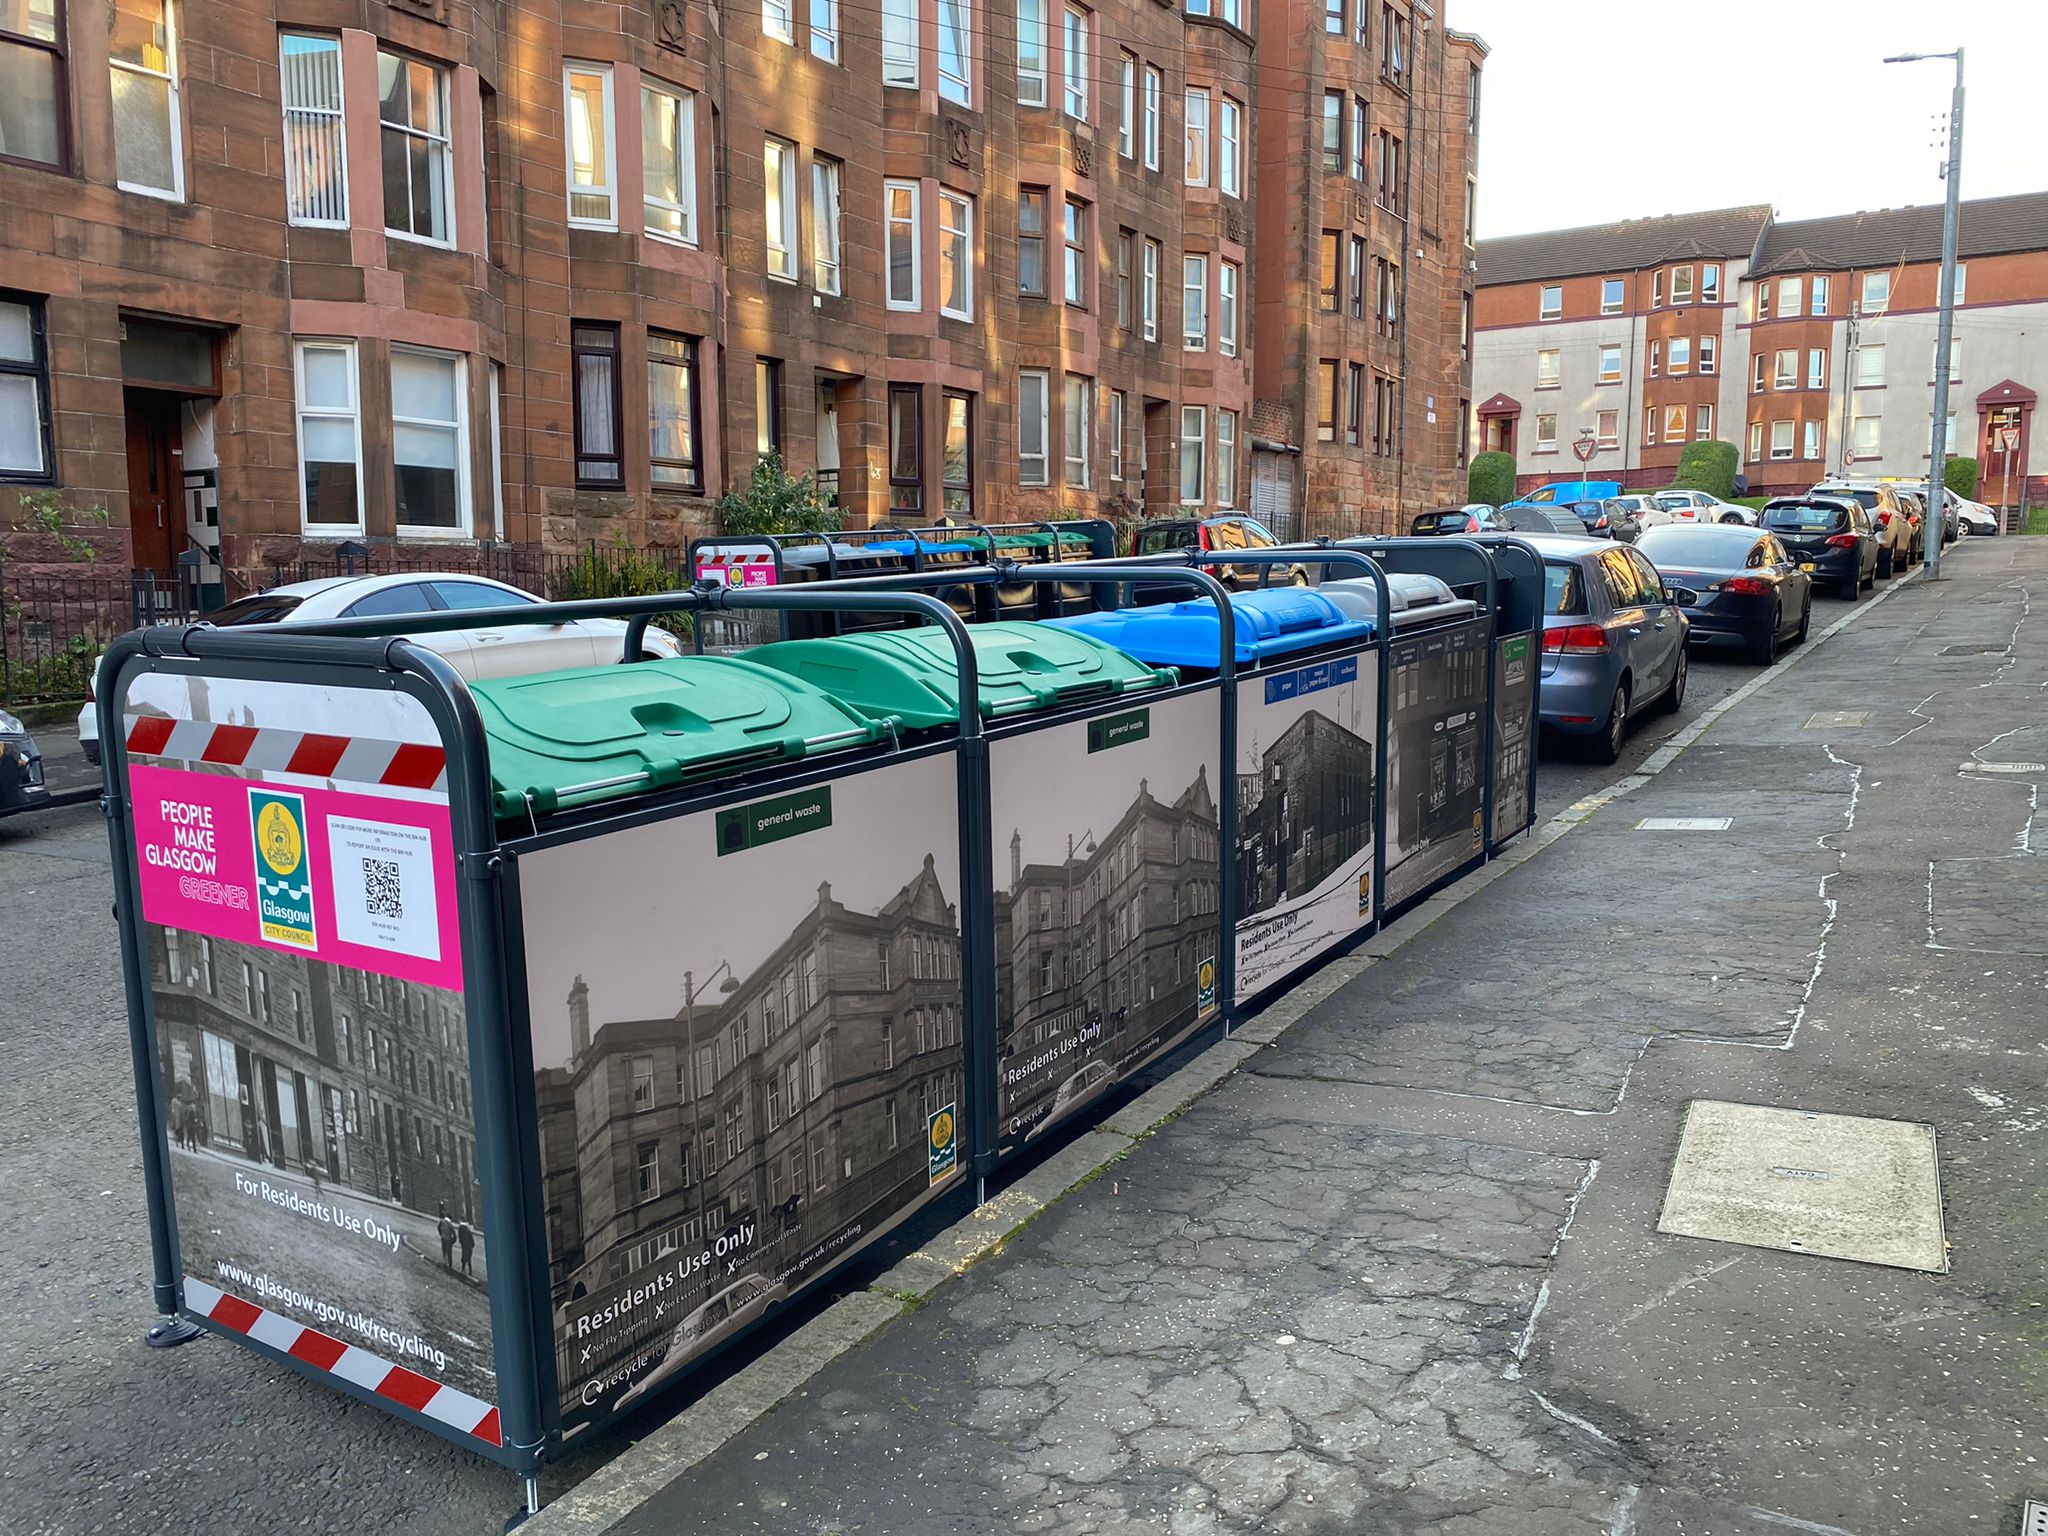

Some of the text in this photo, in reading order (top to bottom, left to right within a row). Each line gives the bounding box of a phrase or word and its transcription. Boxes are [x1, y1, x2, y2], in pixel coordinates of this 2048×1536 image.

[1109, 720, 1144, 738] general waste
[161, 800, 214, 828] PEOPLE
[757, 803, 821, 831] general waste
[174, 827, 216, 853] MAKE
[145, 844, 217, 876] GLASGOW
[179, 875, 250, 911] GREENER
[263, 899, 310, 925] Glasgow
[265, 925, 311, 943] CITY COUNCIL
[1241, 926, 1272, 952] Residents
[1272, 920, 1284, 934] Use
[1008, 1047, 1059, 1085] Residents
[1060, 1036, 1078, 1054] Use
[1079, 1021, 1101, 1043] Only
[1786, 1170, 1815, 1178] CATV
[235, 1172, 401, 1253] For Residents Use Only
[735, 1223, 802, 1268] No Commercial Waste
[577, 1222, 755, 1339] Residents Use Only
[736, 1223, 861, 1308] www.glasgow.gov.uk/recycling
[664, 1272, 722, 1311] No Excess Waste
[217, 1259, 447, 1371] www.glasgow.gov.uk/recycling
[593, 1317, 648, 1353] No Fly Tipping
[605, 1355, 648, 1390] recycle
[671, 1309, 722, 1347] Glasgow
